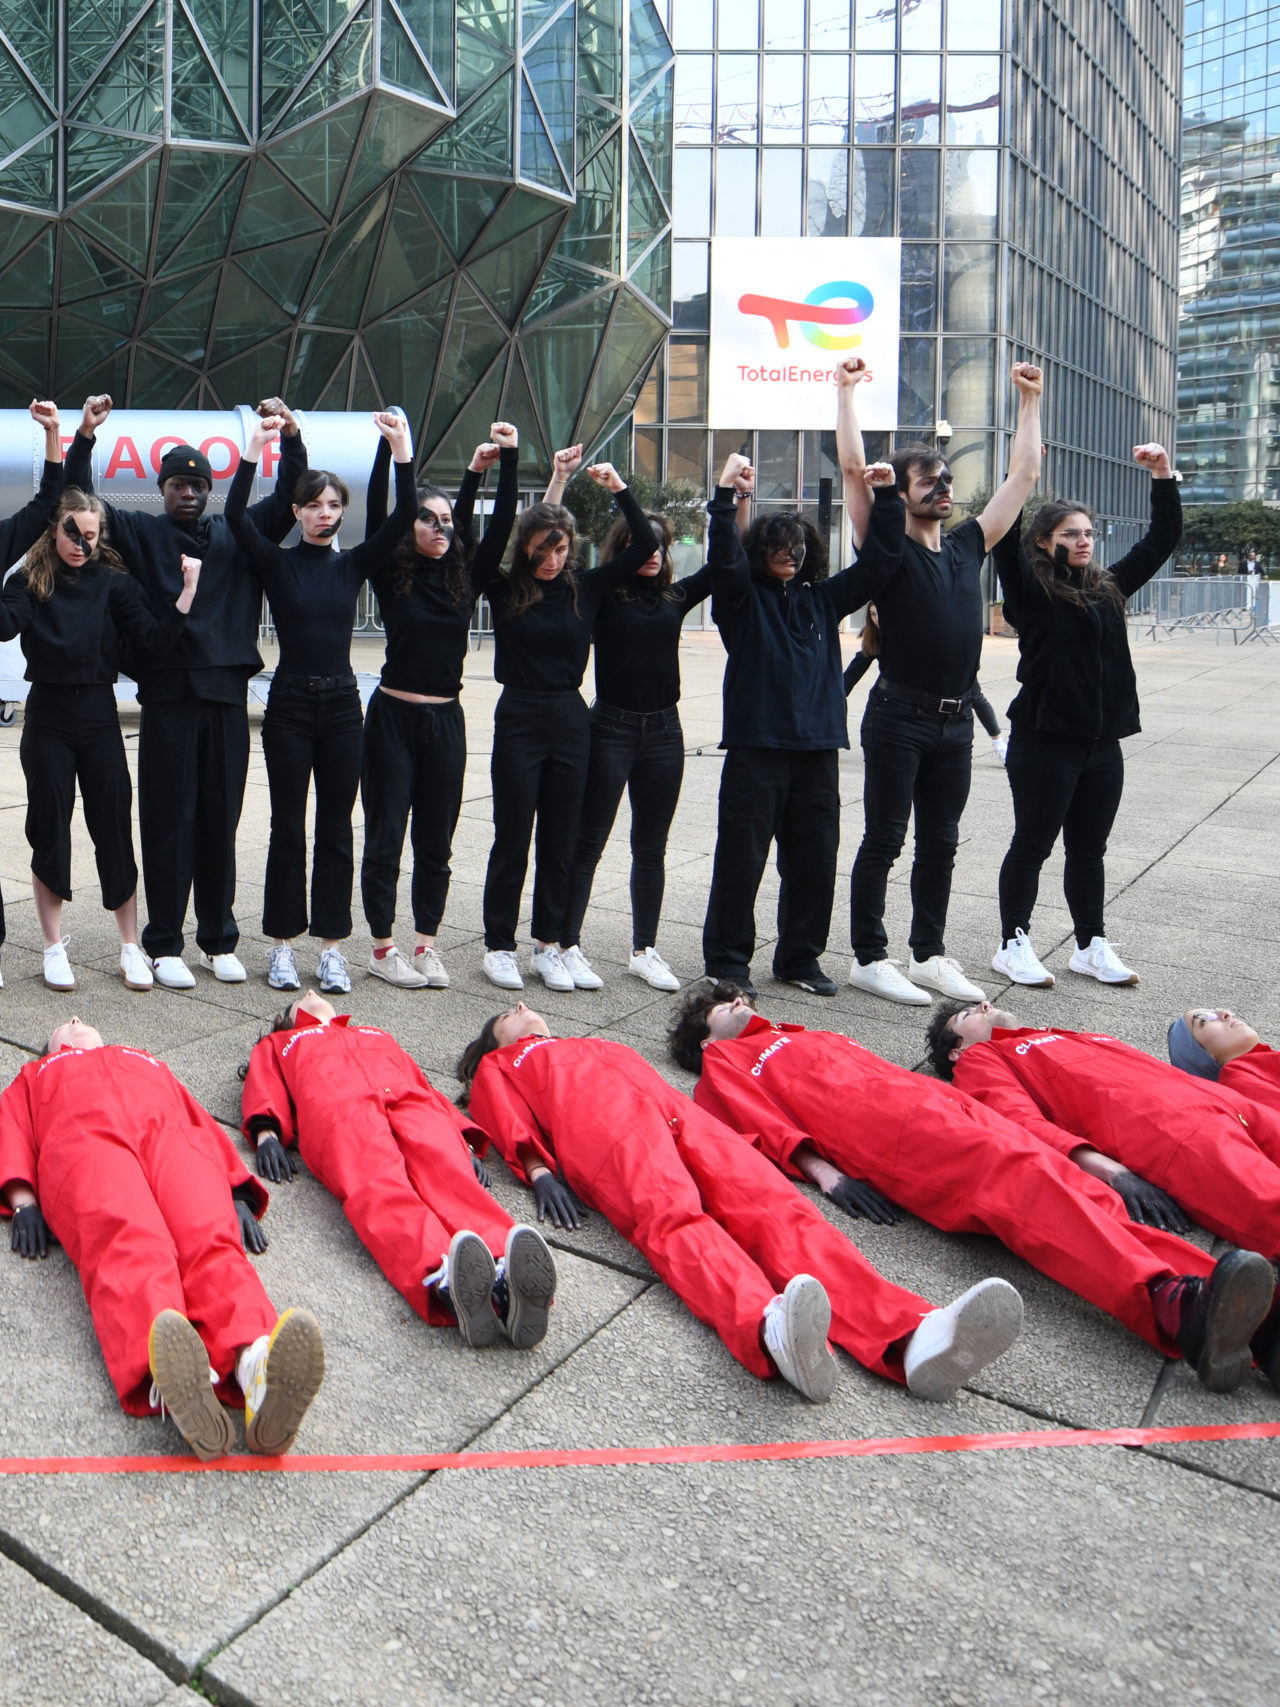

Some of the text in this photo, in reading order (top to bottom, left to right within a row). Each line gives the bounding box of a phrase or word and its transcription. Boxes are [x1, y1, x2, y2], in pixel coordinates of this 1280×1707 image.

[737, 366, 873, 386] TotalEners
[282, 1027, 324, 1057] CLIMATE
[750, 1036, 791, 1076] CLIMATE
